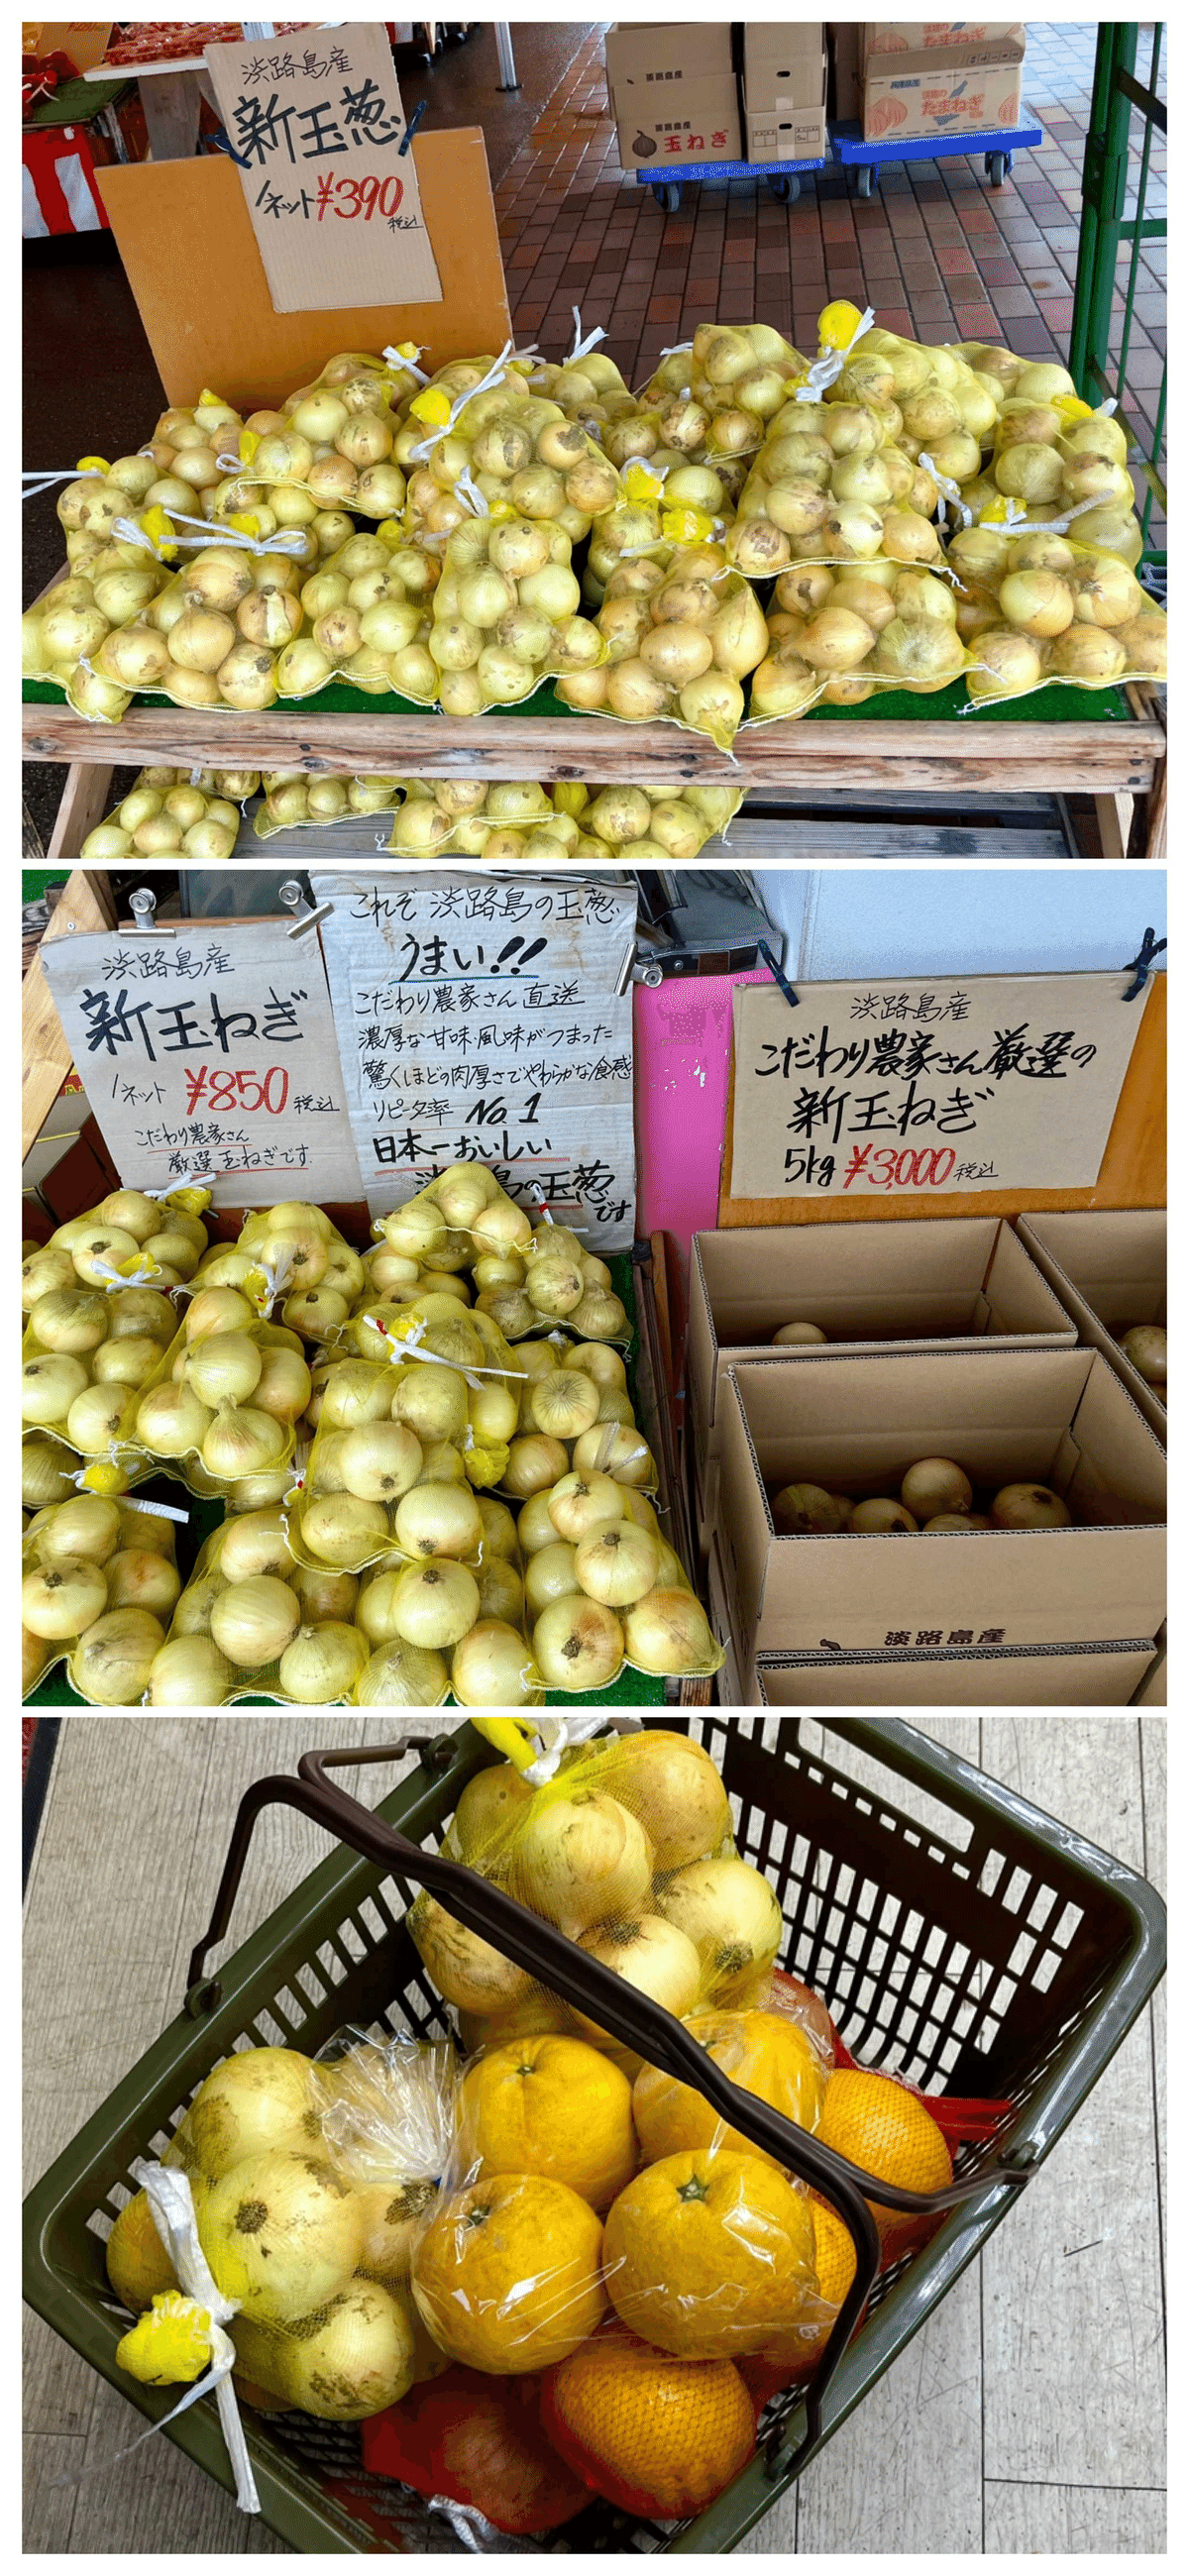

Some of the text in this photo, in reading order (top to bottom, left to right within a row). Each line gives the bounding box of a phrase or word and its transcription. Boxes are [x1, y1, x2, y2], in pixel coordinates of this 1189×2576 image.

[241, 46, 354, 85] 淡路島産
[232, 78, 402, 165] 新玉葱
[663, 128, 729, 154] 玉ねぎ
[316, 171, 404, 222] ¥390
[387, 215, 425, 234] 税込
[101, 943, 236, 981] 淡路島産
[79, 987, 308, 1062] 新玉ねぎ
[849, 991, 972, 1023] 淡路島産
[755, 1022, 1097, 1080] こだわり農家さん厳選の
[183, 1065, 289, 1116] ¥850
[293, 1095, 340, 1115] 税込
[786, 1080, 996, 1143] 新玉ねぎ
[135, 1123, 250, 1147] こだわり農家さん
[373, 1127, 552, 1163] 日本一おいしい
[784, 1144, 836, 1188] 5kg
[953, 1160, 1000, 1182] 税込
[594, 1199, 633, 1224] です
[884, 1628, 1007, 1648] 淡路島産
